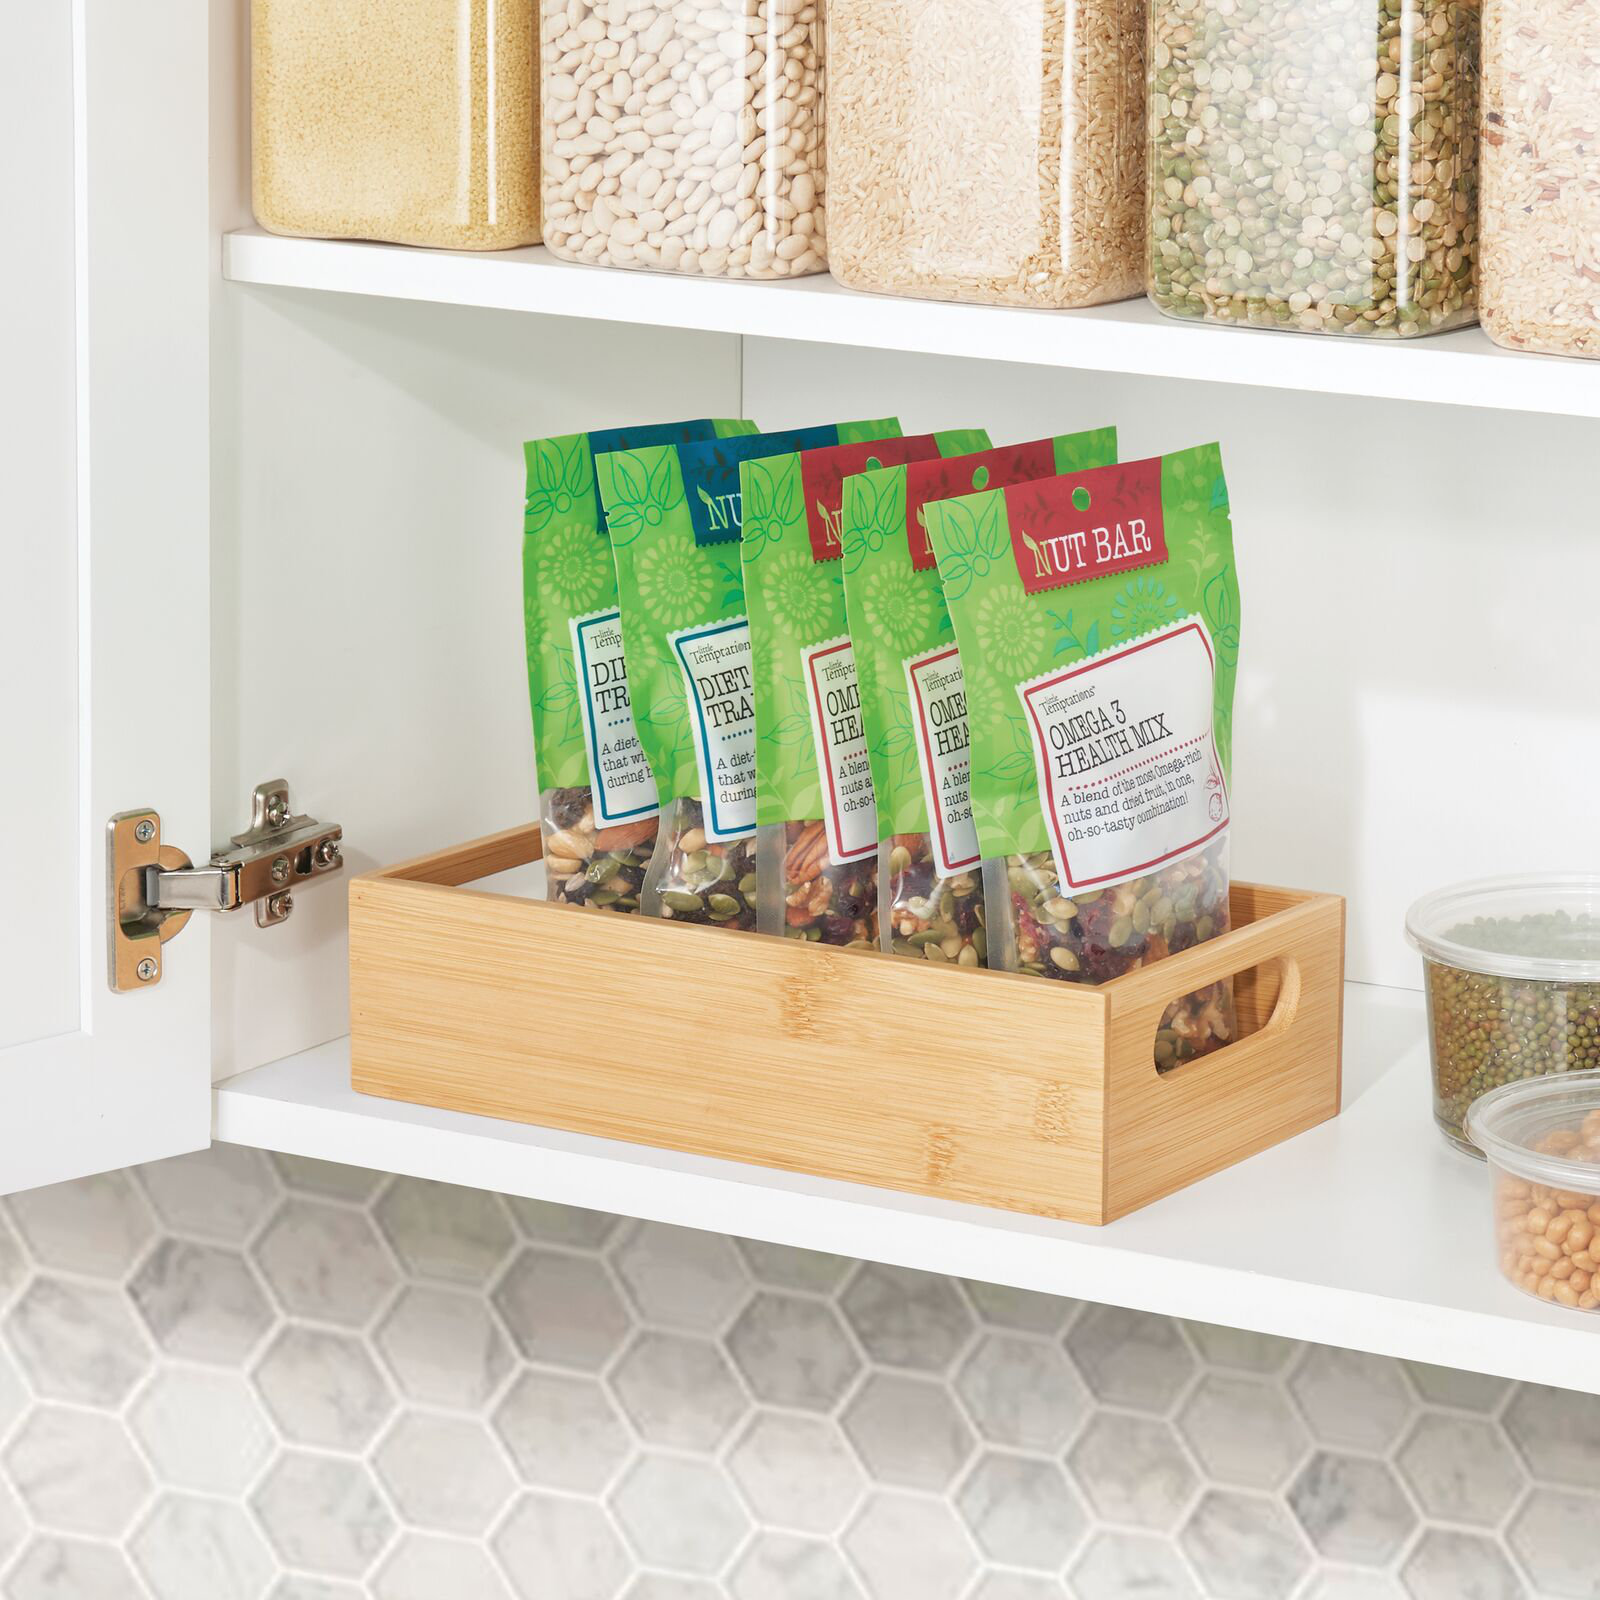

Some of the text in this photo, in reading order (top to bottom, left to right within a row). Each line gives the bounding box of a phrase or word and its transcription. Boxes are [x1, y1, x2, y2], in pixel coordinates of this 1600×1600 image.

[1022, 519, 1152, 577] NUT BAR
[697, 665, 751, 700] DIET
[706, 692, 755, 728] TRA
[1049, 699, 1126, 750] OMEGA 3
[601, 743, 612, 756] A
[1055, 712, 1173, 778] HEALTH MIX
[603, 755, 629, 772] that
[716, 748, 755, 770] A diet-
[839, 760, 869, 779] A blen
[607, 769, 646, 789] during
[718, 771, 746, 786] that
[841, 776, 873, 796] nuts a
[943, 776, 952, 791] A
[1060, 747, 1203, 808] A blend of the most Omega-rich
[944, 789, 969, 807] nuts
[1063, 772, 1196, 825] nuts and dried fruit, in one,
[1066, 791, 1190, 842] oh-so-tasty combination!
